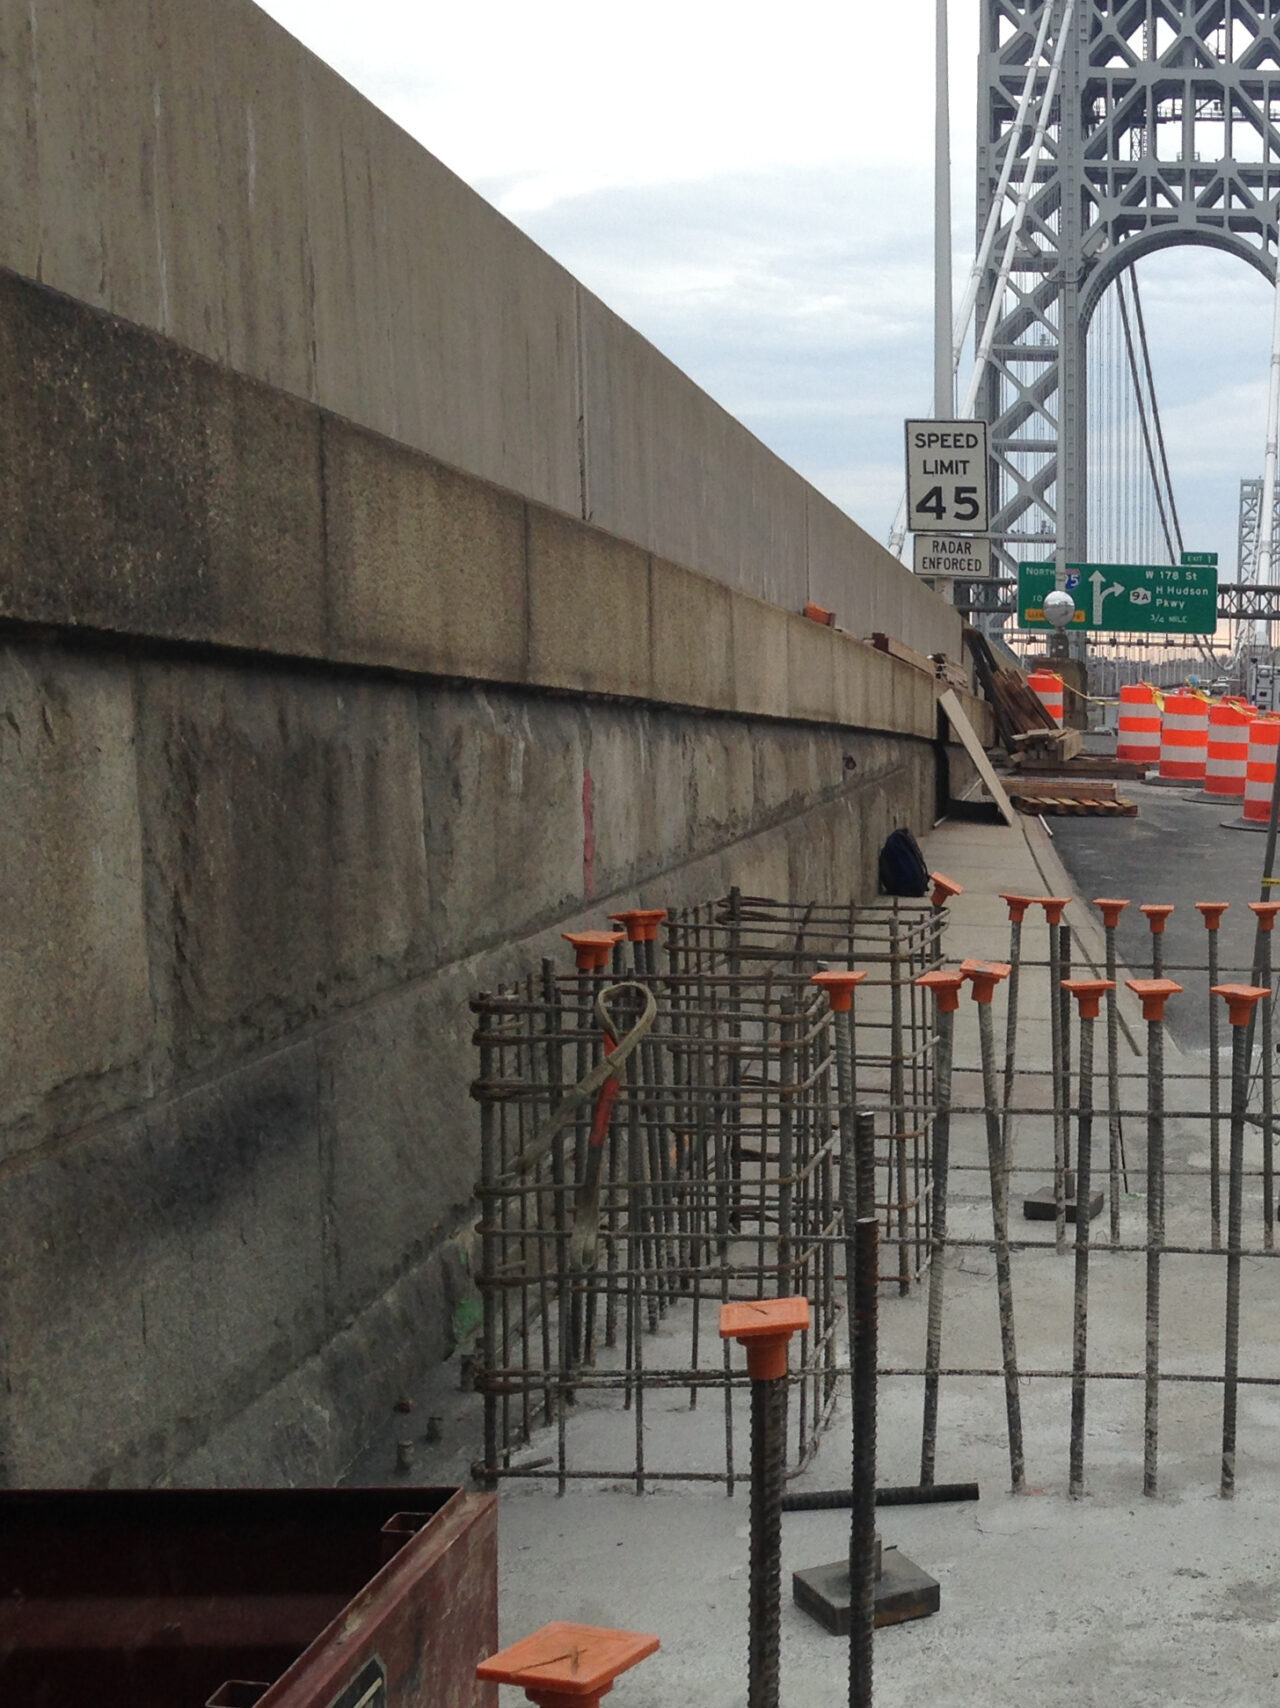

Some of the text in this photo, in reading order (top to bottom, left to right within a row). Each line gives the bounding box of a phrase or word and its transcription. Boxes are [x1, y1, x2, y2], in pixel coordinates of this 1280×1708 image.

[915, 433, 978, 449] SPEED
[923, 460, 970, 475] LIMIT
[916, 486, 979, 521] 45
[932, 540, 972, 555] RADAR
[922, 557, 982, 572] ENFORCED
[1026, 567, 1055, 576] NORTH
[1145, 570, 1197, 581] W 178 St
[1131, 591, 1149, 601] 9A
[1155, 586, 1209, 596] H Hudson
[1155, 599, 1185, 610] Pkwy
[1168, 615, 1188, 624] MILE
